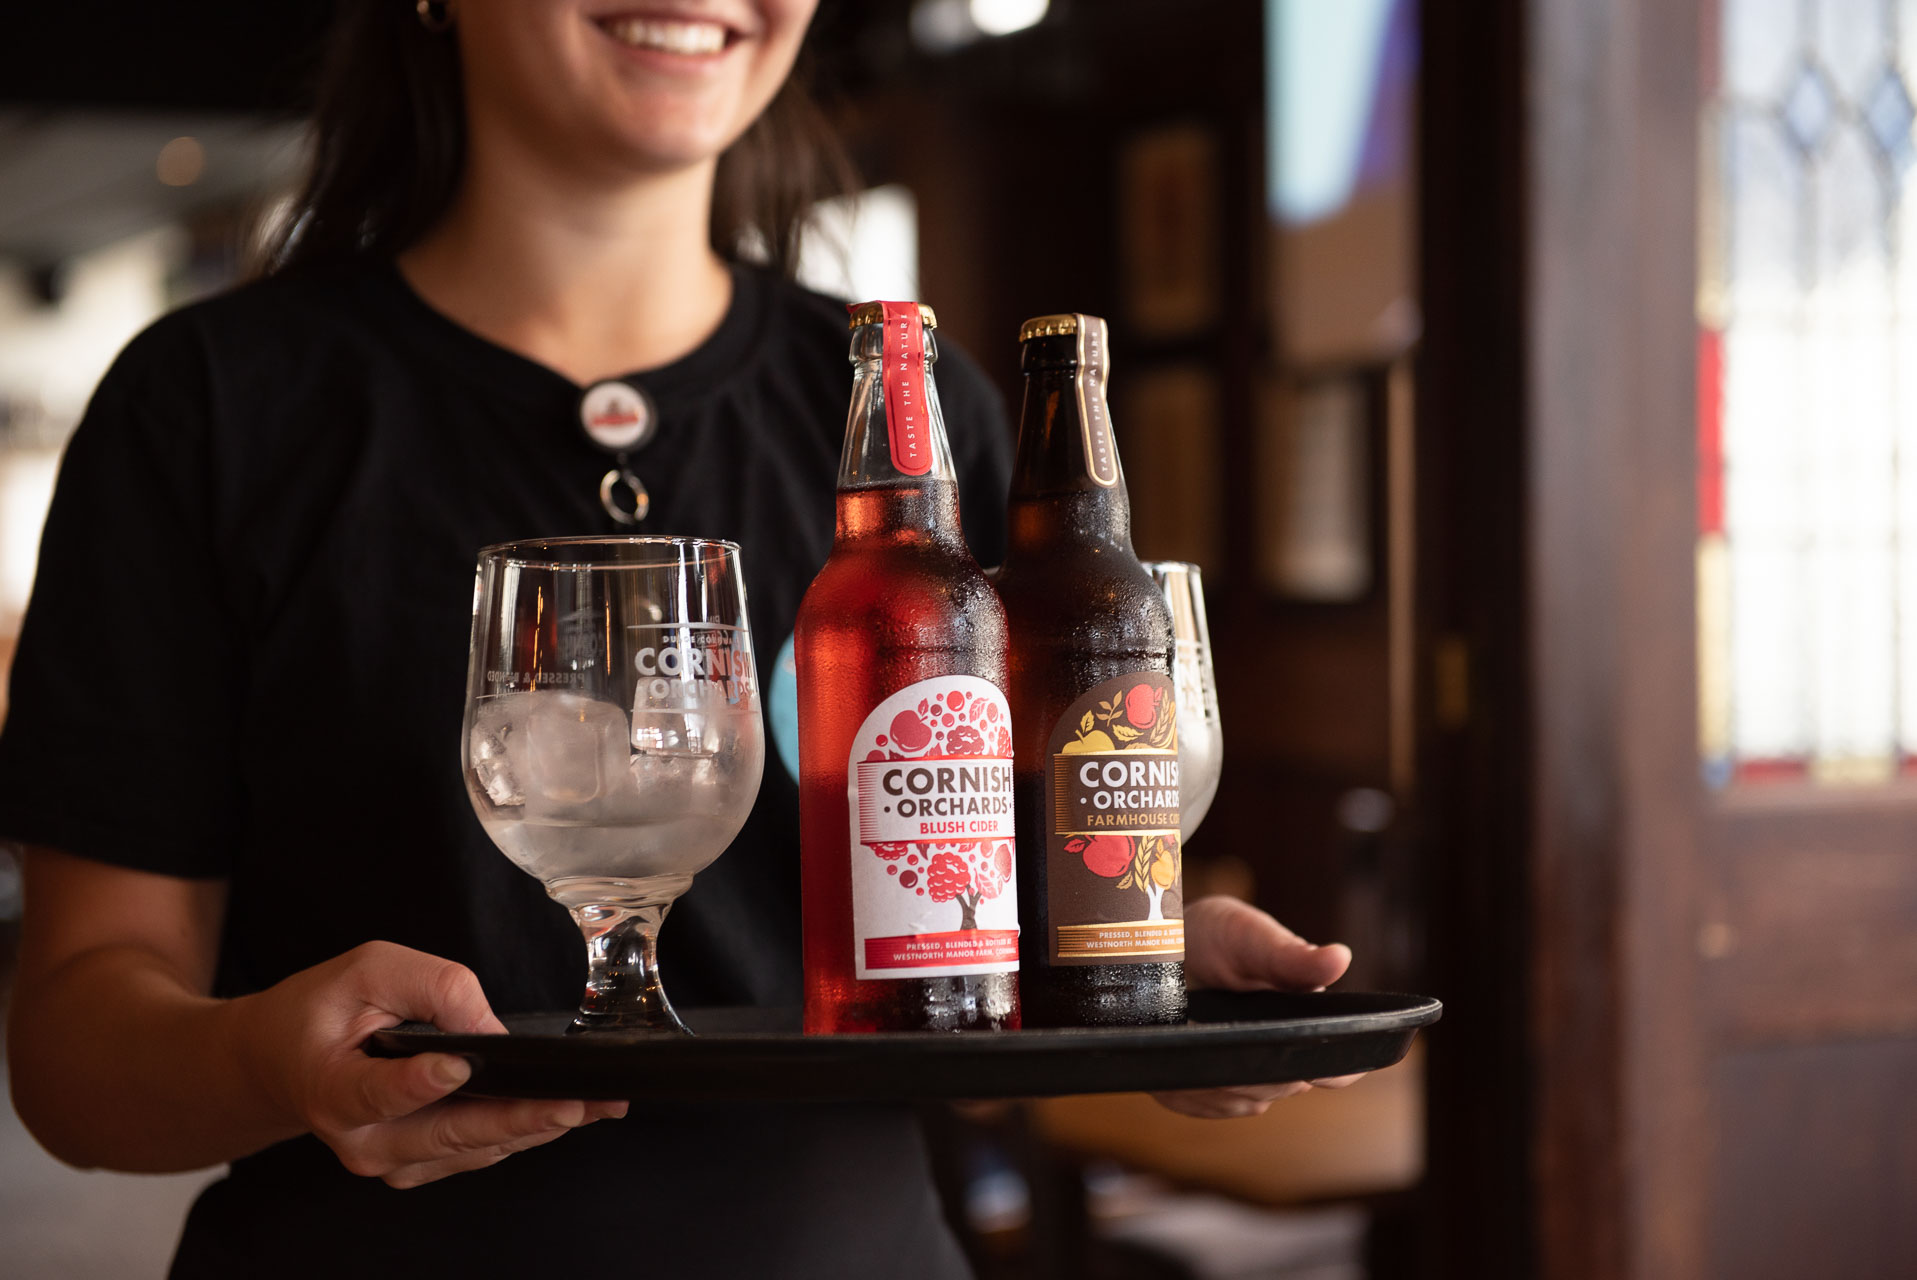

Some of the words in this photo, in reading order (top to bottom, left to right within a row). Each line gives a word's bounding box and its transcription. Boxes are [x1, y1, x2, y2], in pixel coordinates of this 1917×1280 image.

[900, 314, 909, 371] NATURE
[902, 381, 911, 406] THE
[1092, 396, 1102, 420] THE
[905, 415, 918, 458] TASTE
[1097, 430, 1109, 472] TASTE
[634, 647, 752, 678] CORNISH
[882, 766, 1012, 796] CORNISH
[1079, 761, 1179, 788] CORNIS
[897, 796, 1008, 818] ORCHARDS
[920, 821, 965, 834] BLUSH
[969, 820, 999, 833] CIDER
[1087, 813, 1168, 826] FARMHOUSE
[906, 942, 943, 951] PRESSED,
[945, 941, 978, 949] BLENDED
[1086, 940, 1133, 949] WESTNORTH
[1135, 939, 1161, 947] MANOR
[1099, 931, 1133, 939] PRESSED,
[893, 951, 944, 961] WESTNORTH
[946, 950, 975, 959] MANOR
